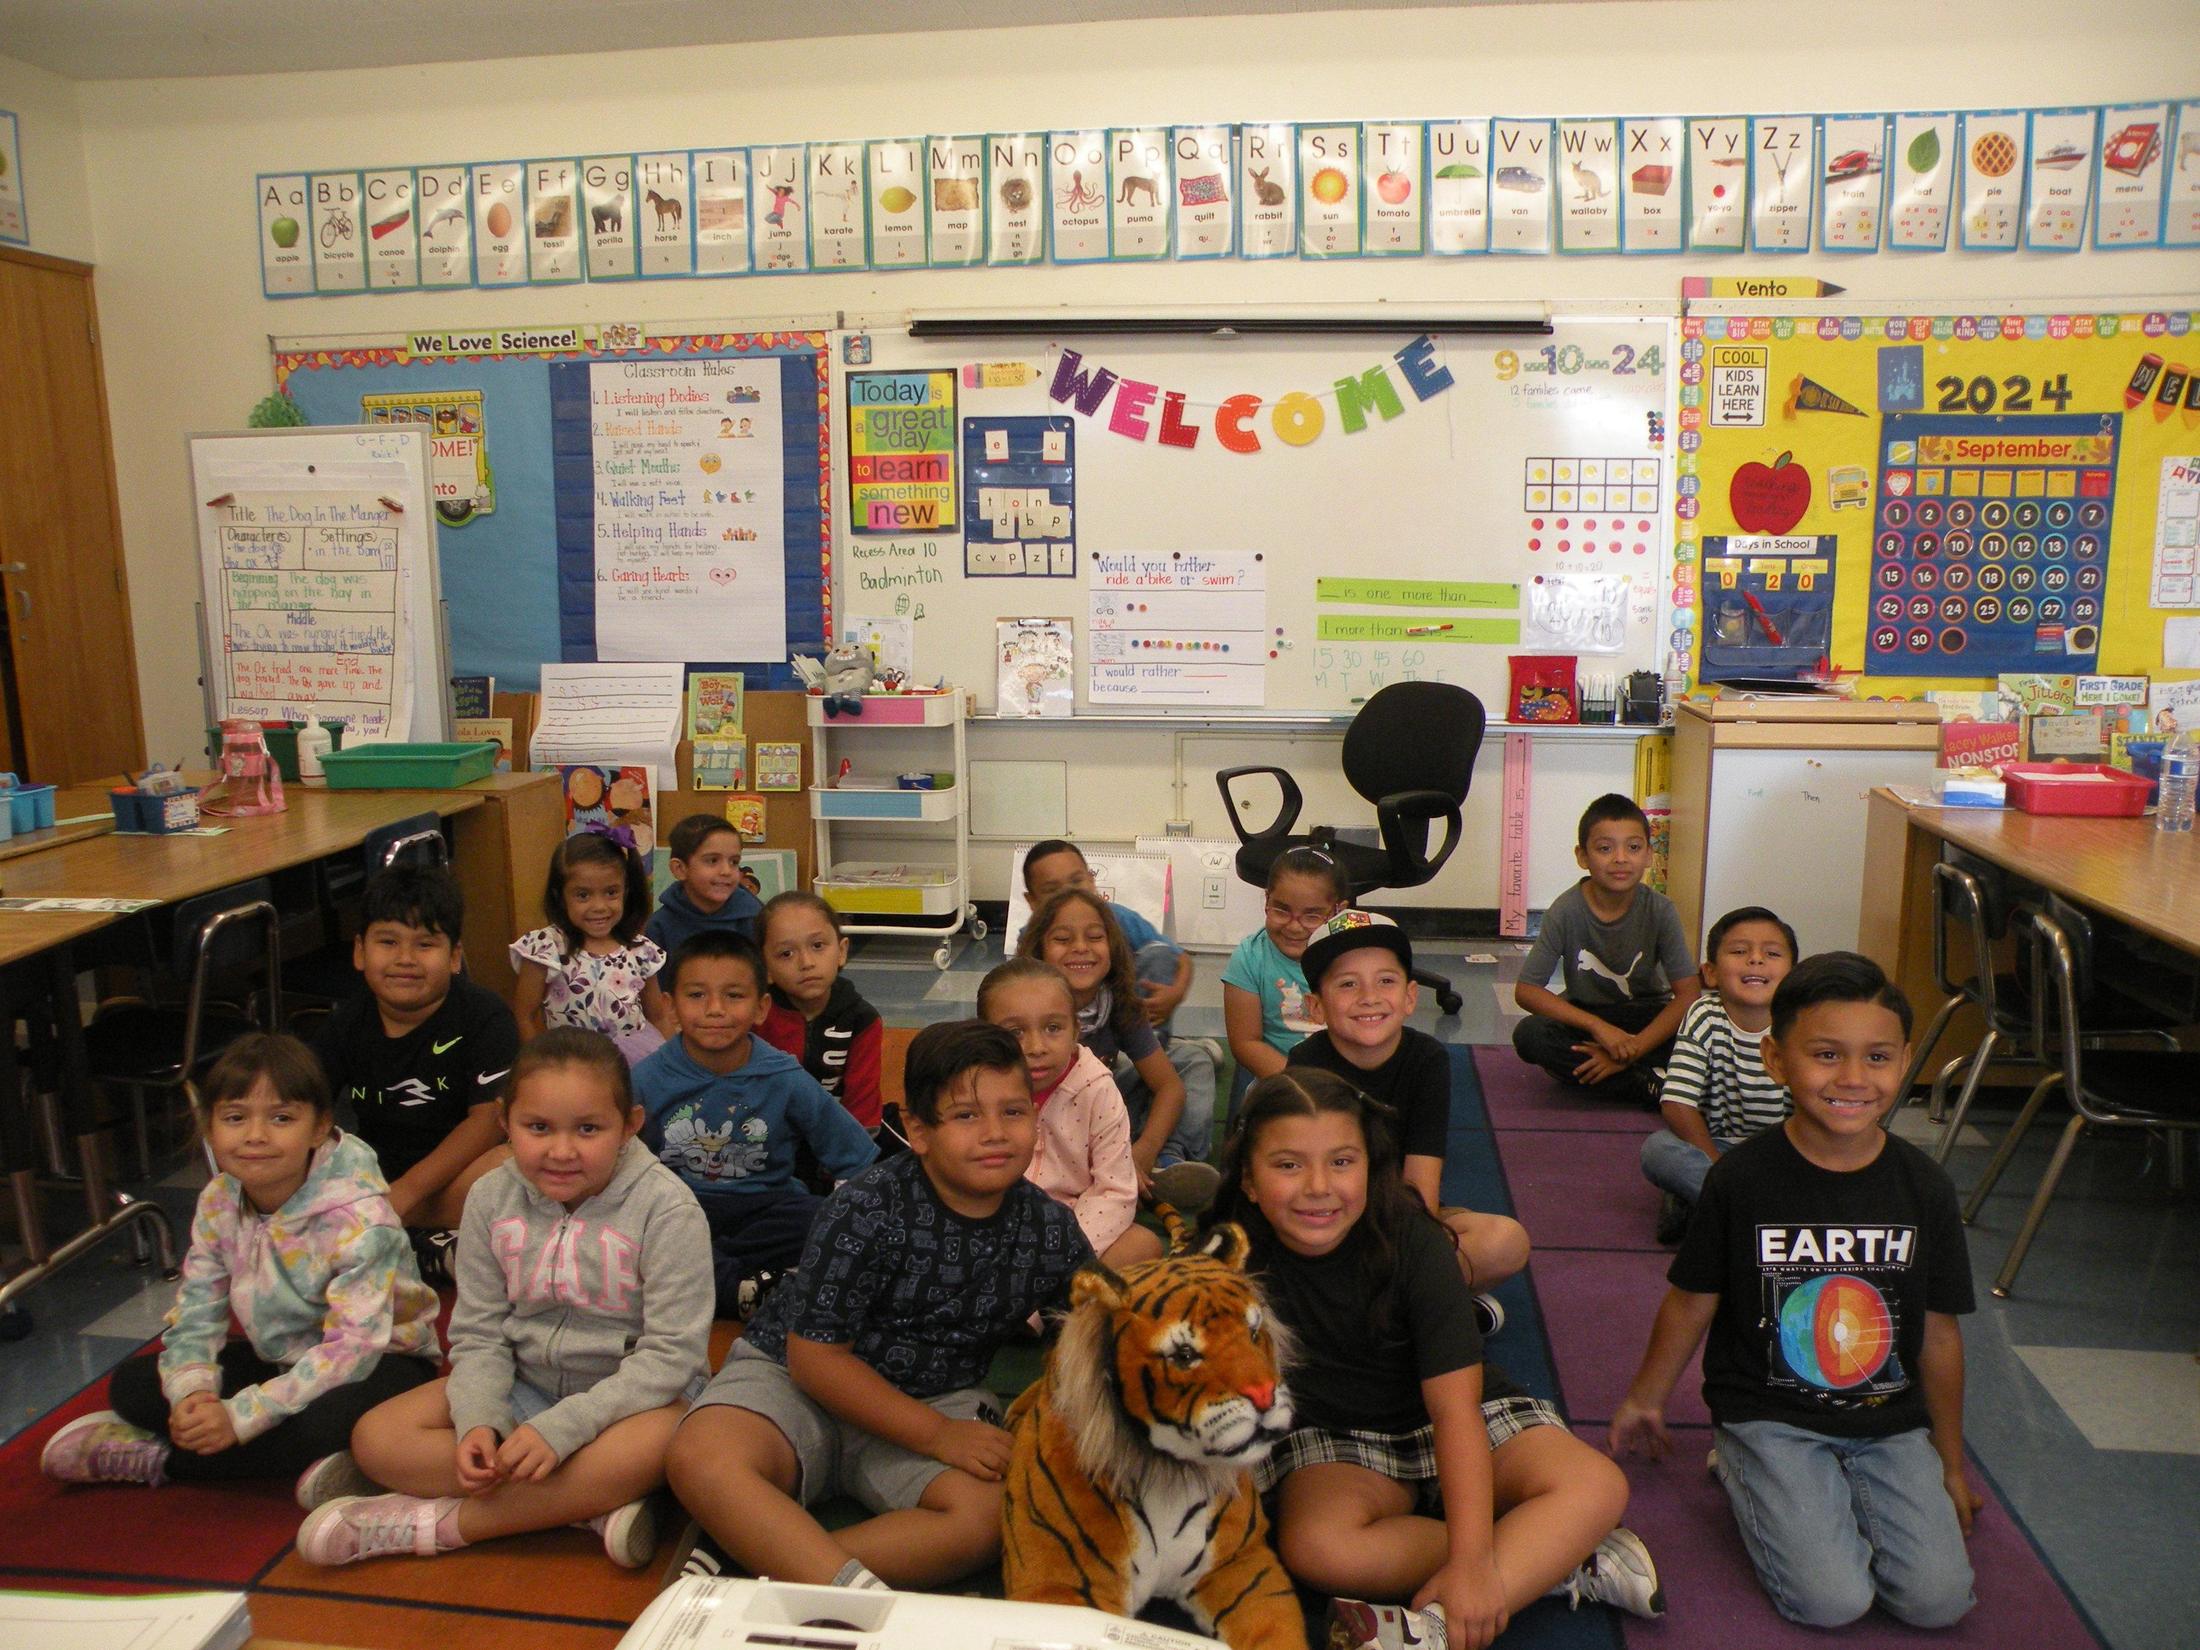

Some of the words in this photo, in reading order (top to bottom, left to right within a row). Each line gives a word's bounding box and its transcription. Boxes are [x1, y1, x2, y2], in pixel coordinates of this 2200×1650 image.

[1987, 187, 2002, 196] pie
[2049, 187, 2072, 196] boat
[2115, 184, 2144, 193] menu
[1377, 209, 1410, 218] tomato
[1439, 207, 1481, 217] umbrella
[1570, 206, 1607, 217] wallaby
[1643, 206, 1661, 215] box
[1769, 203, 1797, 215] zipper
[1062, 216, 1099, 226] octopus
[1126, 215, 1153, 224] puma
[1194, 212, 1215, 223] quilt
[1254, 211, 1283, 220] rabbit
[824, 226, 853, 234] karate
[884, 224, 912, 232] lemon
[947, 222, 968, 231] map
[1008, 220, 1027, 228] nest
[597, 235, 624, 246] gorilla
[654, 233, 677, 242] horse
[713, 232, 732, 241] inch
[768, 229, 792, 240] jump
[323, 250, 354, 260] bicycle
[378, 248, 405, 256] canoe
[428, 244, 461, 255] dolphin
[493, 245, 509, 254] egg
[275, 253, 300, 264] apple
[1736, 280, 1788, 297] Vento
[414, 336, 443, 353] We
[446, 335, 492, 351] Love
[501, 330, 578, 349] Science!
[1722, 351, 1759, 364] COOL
[624, 363, 695, 379] Classroom
[703, 361, 735, 376] Rules
[1726, 370, 1753, 382] KIDS
[856, 380, 927, 406] Today
[931, 386, 942, 400] is
[1049, 334, 1455, 454] WELCOME
[1523, 384, 1559, 395] families
[1719, 384, 1759, 396] LEARN
[1937, 374, 2072, 414] 2024
[604, 389, 665, 409] Listening
[670, 386, 710, 403] Bodies
[1722, 397, 1754, 411] HERE
[856, 422, 864, 433] a
[873, 405, 947, 437] great
[888, 426, 931, 453] day
[993, 441, 1000, 449] e
[1051, 442, 1058, 450] u
[1957, 439, 2071, 462] September
[606, 458, 634, 475] Quiet
[641, 458, 680, 475] Mouths
[857, 464, 870, 476] to
[873, 456, 942, 480] learn
[859, 484, 950, 502] something
[609, 490, 654, 511] Walking
[659, 490, 686, 506] Feet
[228, 505, 255, 522] Title
[266, 506, 285, 522] The
[290, 505, 312, 525] Dog
[315, 505, 326, 521] In
[329, 506, 347, 522] The
[350, 505, 389, 527] Manger
[874, 504, 934, 525] new
[1895, 509, 1899, 519] 1
[1926, 510, 1933, 520] 2
[1957, 510, 1964, 520] 3
[1991, 510, 1999, 520] 4
[2024, 510, 2031, 520] 5
[2056, 510, 2063, 520] 6
[2089, 511, 2096, 520] 7
[613, 524, 663, 543] Helping
[669, 522, 707, 537] Hands
[1762, 538, 1771, 549] in
[1775, 538, 1810, 549] School
[1886, 540, 1894, 550] 8
[1923, 541, 1930, 551] 9
[1952, 541, 1964, 551] 10
[1989, 541, 1999, 551] 11
[2018, 542, 2030, 551] 12
[2049, 542, 2061, 552] 13
[2081, 541, 2092, 553] 14
[853, 545, 885, 559] Recess
[889, 543, 915, 556] Area
[924, 542, 937, 557] 10
[1097, 555, 1135, 573] Would
[1142, 563, 1166, 577] you
[1175, 557, 1215, 573] rather
[653, 565, 689, 582] Hearts
[860, 566, 943, 590] Badminton
[1106, 573, 1129, 585] ride
[1136, 576, 1144, 585] a
[1149, 573, 1173, 585] bike
[1180, 575, 1195, 586] or
[1886, 571, 1898, 582] 15
[1918, 571, 1931, 582] 16
[1951, 573, 1963, 582] 17
[1985, 574, 1997, 583] 18
[2017, 574, 2029, 583] 19
[2049, 574, 2063, 584] 20
[2083, 574, 2095, 584] 21
[1723, 572, 1732, 586] 0
[1769, 575, 1778, 588] 2
[1802, 575, 1811, 588] 0
[1366, 588, 1391, 599] one
[1402, 589, 1433, 600] more
[1440, 587, 1466, 602] than
[1883, 604, 1898, 613] 22
[1914, 604, 1928, 613] 23
[1947, 605, 1961, 615] 24
[1981, 605, 1995, 615] 25
[2013, 605, 2028, 615] 26
[2045, 605, 2059, 615] 27
[2077, 605, 2091, 615] 28
[1335, 624, 1365, 635] more
[1370, 621, 1402, 636] than
[1879, 633, 1893, 645] 29
[1912, 635, 1927, 645] 30
[1091, 666, 1097, 676] I
[1106, 665, 1135, 677] would
[1142, 664, 1181, 677] rather
[701, 679, 720, 691] Boy
[1094, 680, 1138, 693] because
[2080, 680, 2106, 691] FIRST
[2110, 680, 2143, 691] GRADE
[2028, 684, 2072, 705] Jitters
[1800, 791, 1820, 803] Then
[1509, 812, 1524, 840] table
[1506, 909, 1525, 931] My
[1761, 1229, 1912, 1263] EARTH
